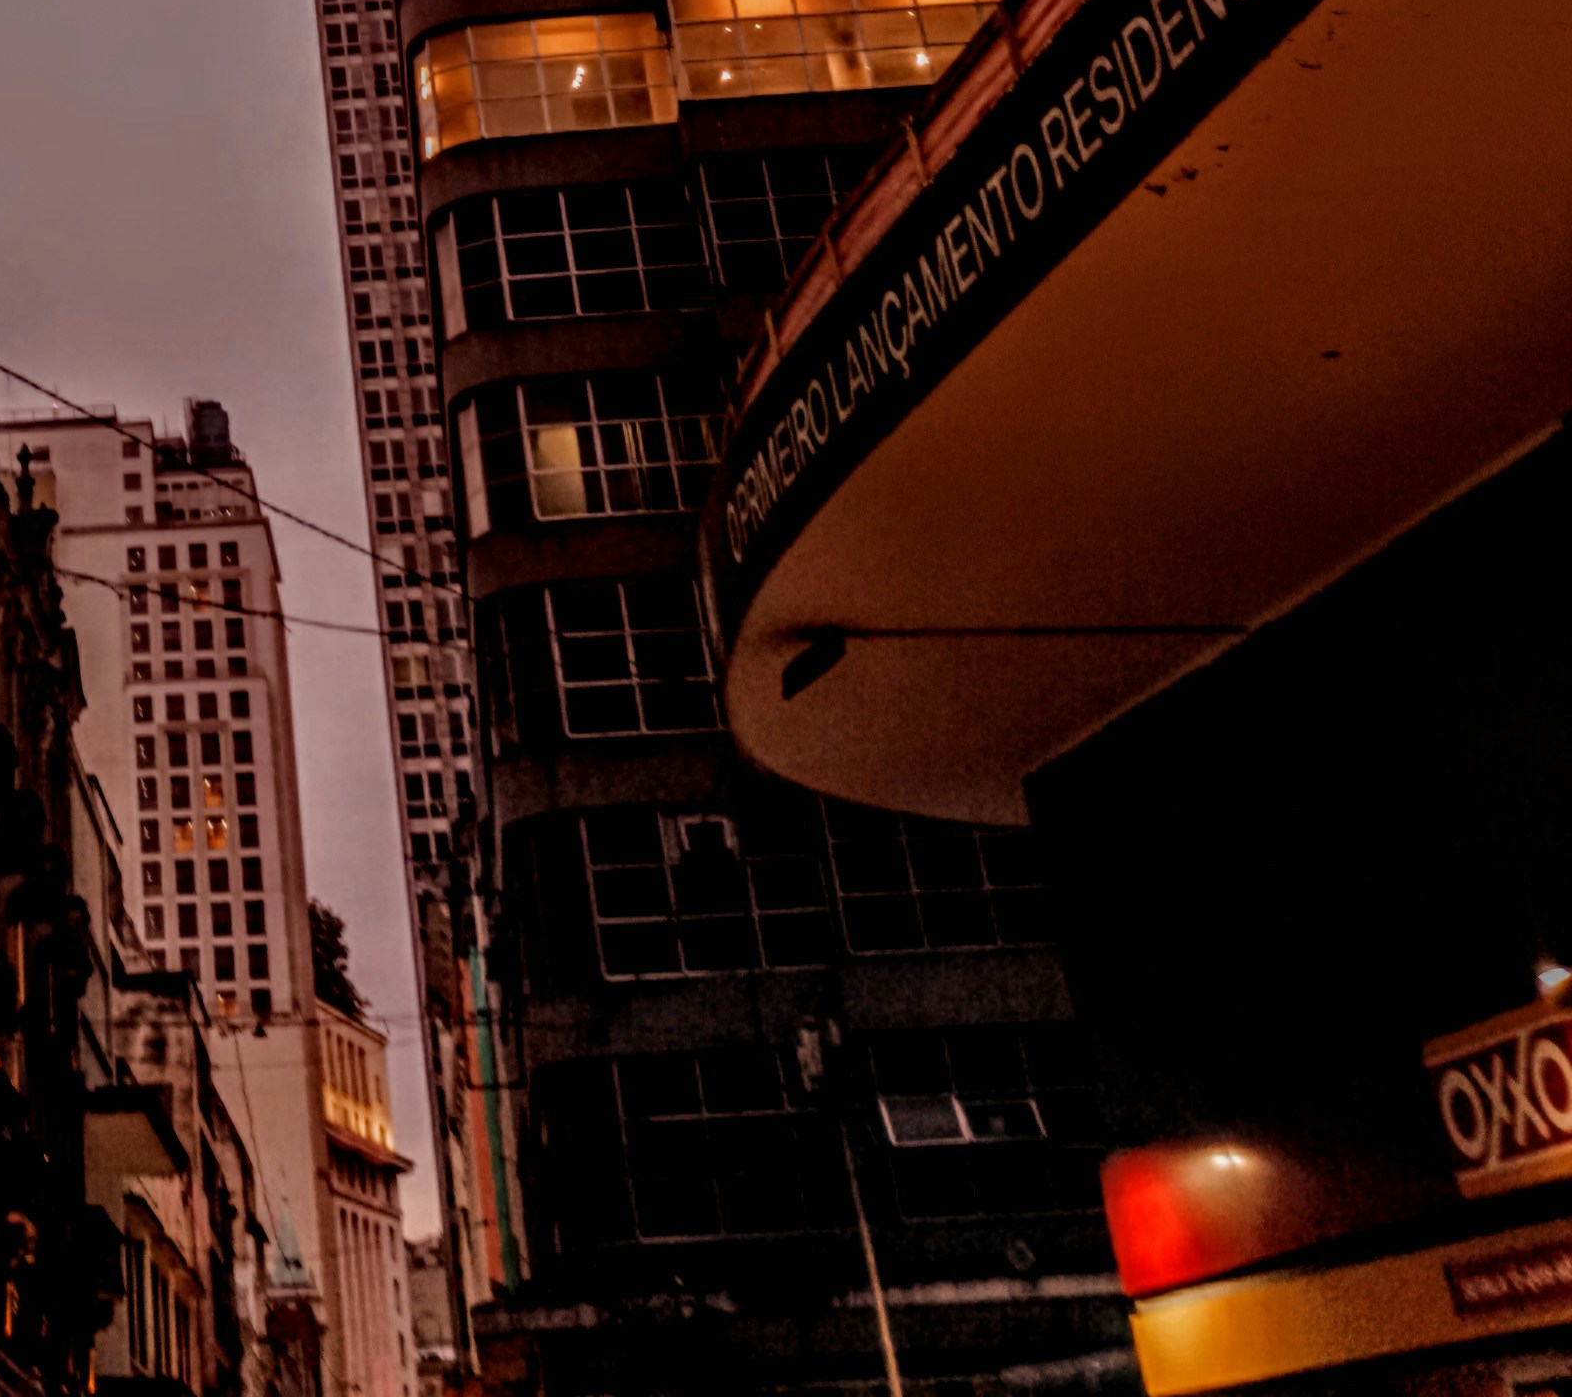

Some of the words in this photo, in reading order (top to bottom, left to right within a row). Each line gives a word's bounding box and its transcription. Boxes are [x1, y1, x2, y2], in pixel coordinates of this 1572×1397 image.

[726, 501, 743, 565] O
[736, 377, 830, 547] PRIMEIRO
[826, 142, 1045, 426] LANÇAMENTO
[1438, 1027, 1572, 1169] OXXO
